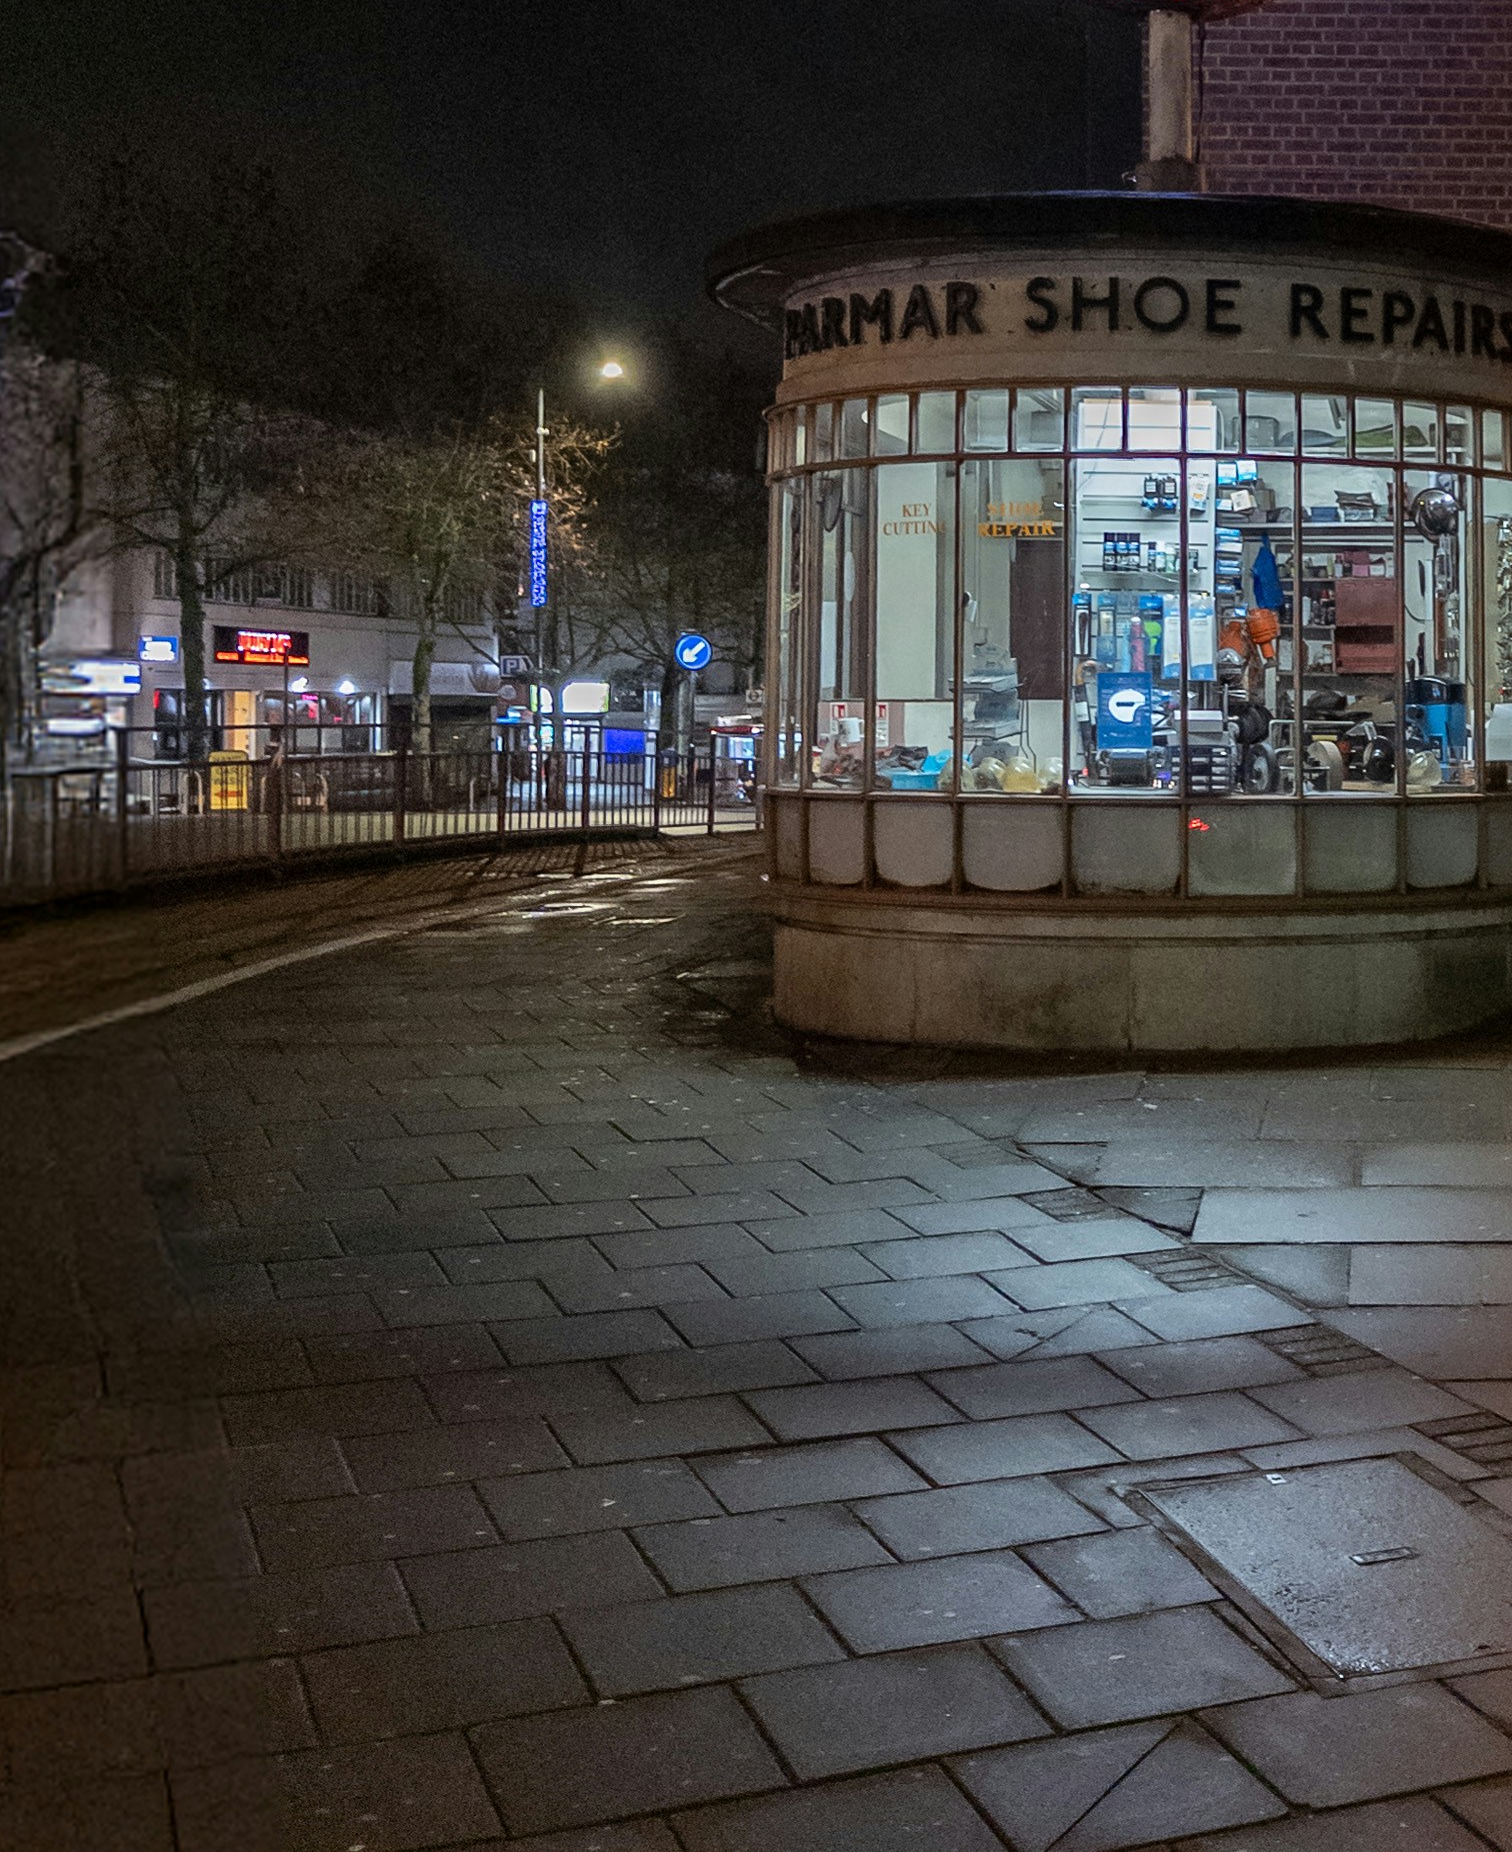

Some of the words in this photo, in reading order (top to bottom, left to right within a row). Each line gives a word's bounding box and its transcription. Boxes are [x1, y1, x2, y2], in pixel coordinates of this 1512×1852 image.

[1024, 276, 1242, 334] SHOE
[902, 503, 931, 517] KEY
[978, 519, 1056, 538] REPAIR
